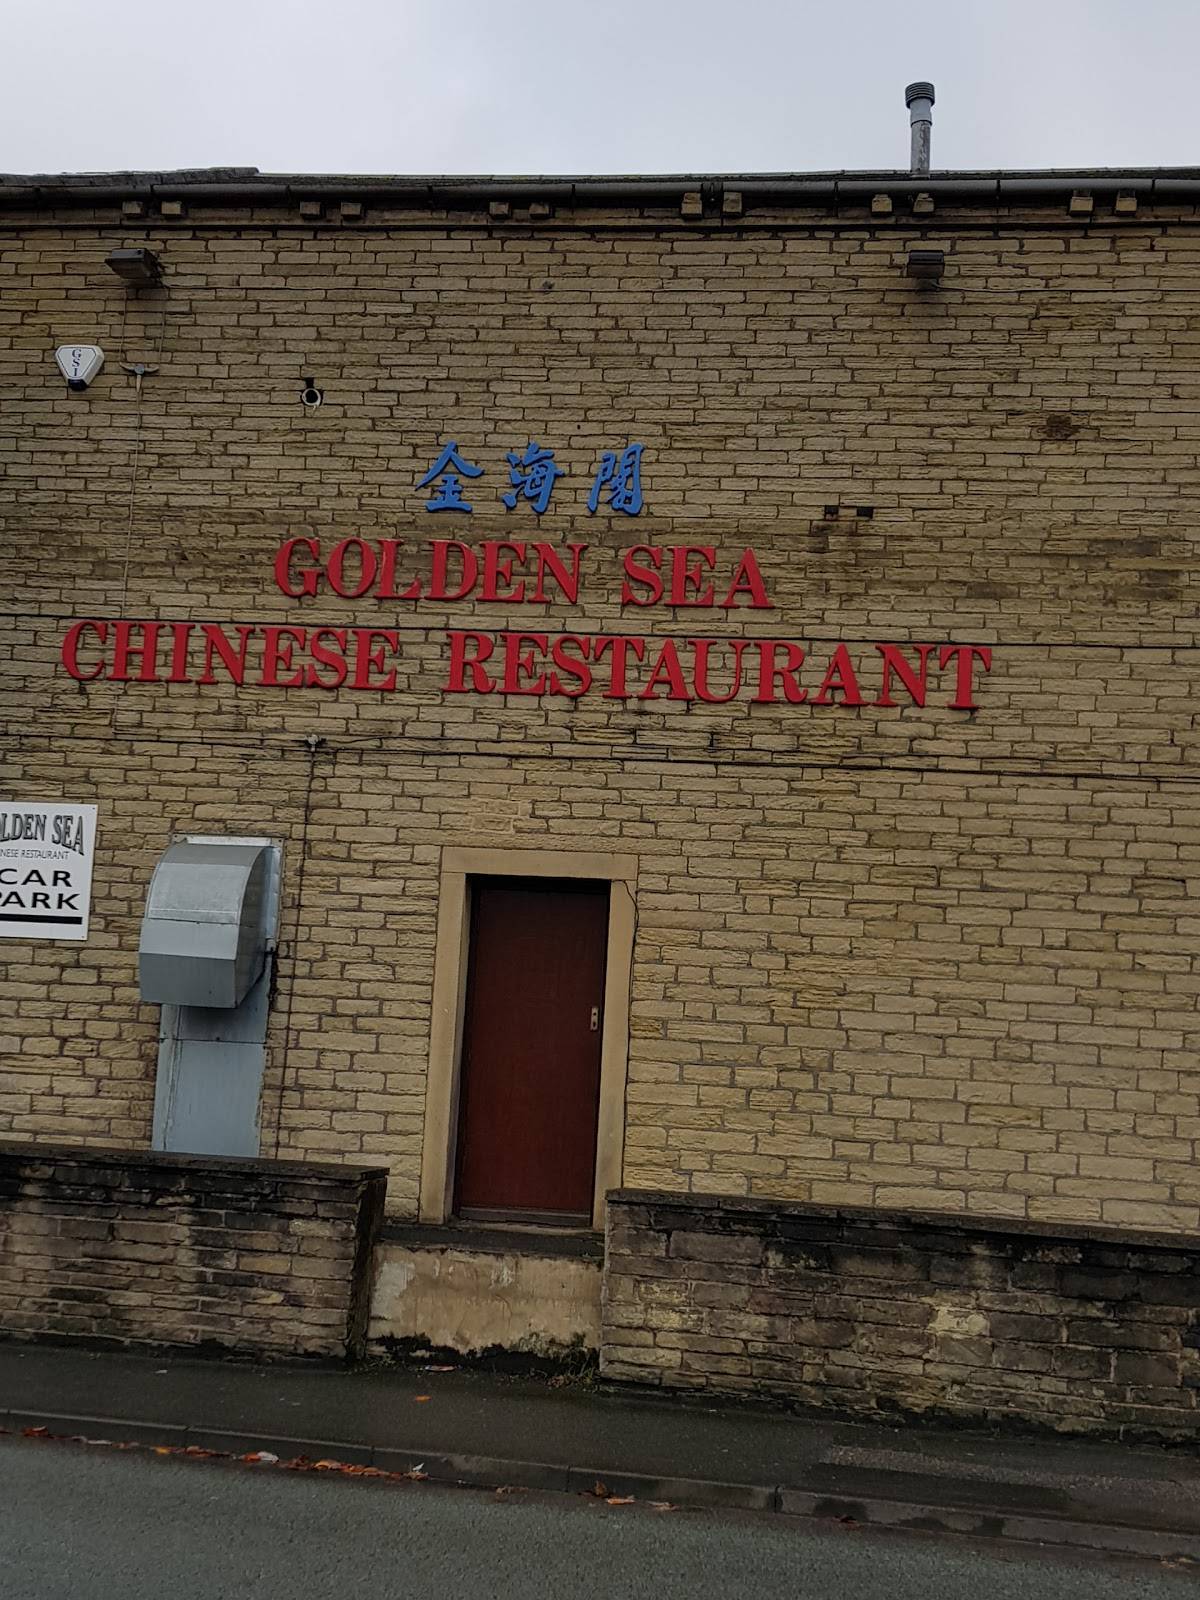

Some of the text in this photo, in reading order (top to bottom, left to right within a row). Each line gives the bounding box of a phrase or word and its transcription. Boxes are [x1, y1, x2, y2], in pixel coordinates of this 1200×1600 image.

[273, 537, 775, 609] GOLDEN SEA
[61, 619, 993, 710] CHINESE RESTAURANT
[0, 813, 84, 856] LDEN SEA
[20, 849, 69, 860] RESTAURANT
[0, 868, 72, 888] CAR
[0, 891, 80, 910] ARK
